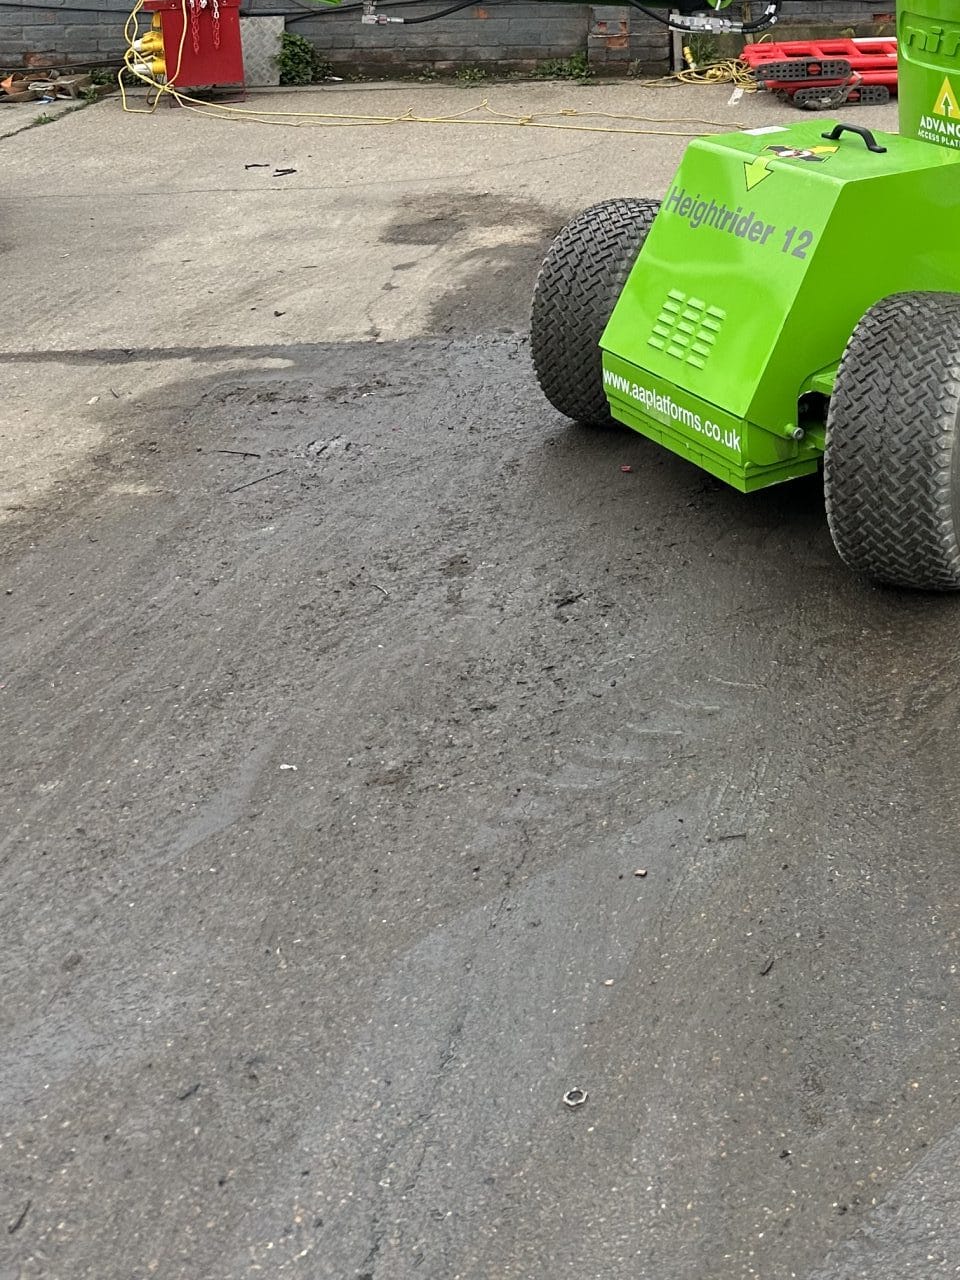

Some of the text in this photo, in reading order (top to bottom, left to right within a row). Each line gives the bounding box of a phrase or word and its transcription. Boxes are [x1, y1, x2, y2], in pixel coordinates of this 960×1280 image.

[917, 129, 940, 143] ACCESS
[664, 185, 814, 260] Heightrider 12
[603, 368, 741, 453] www.aaplatforms.co.uk
